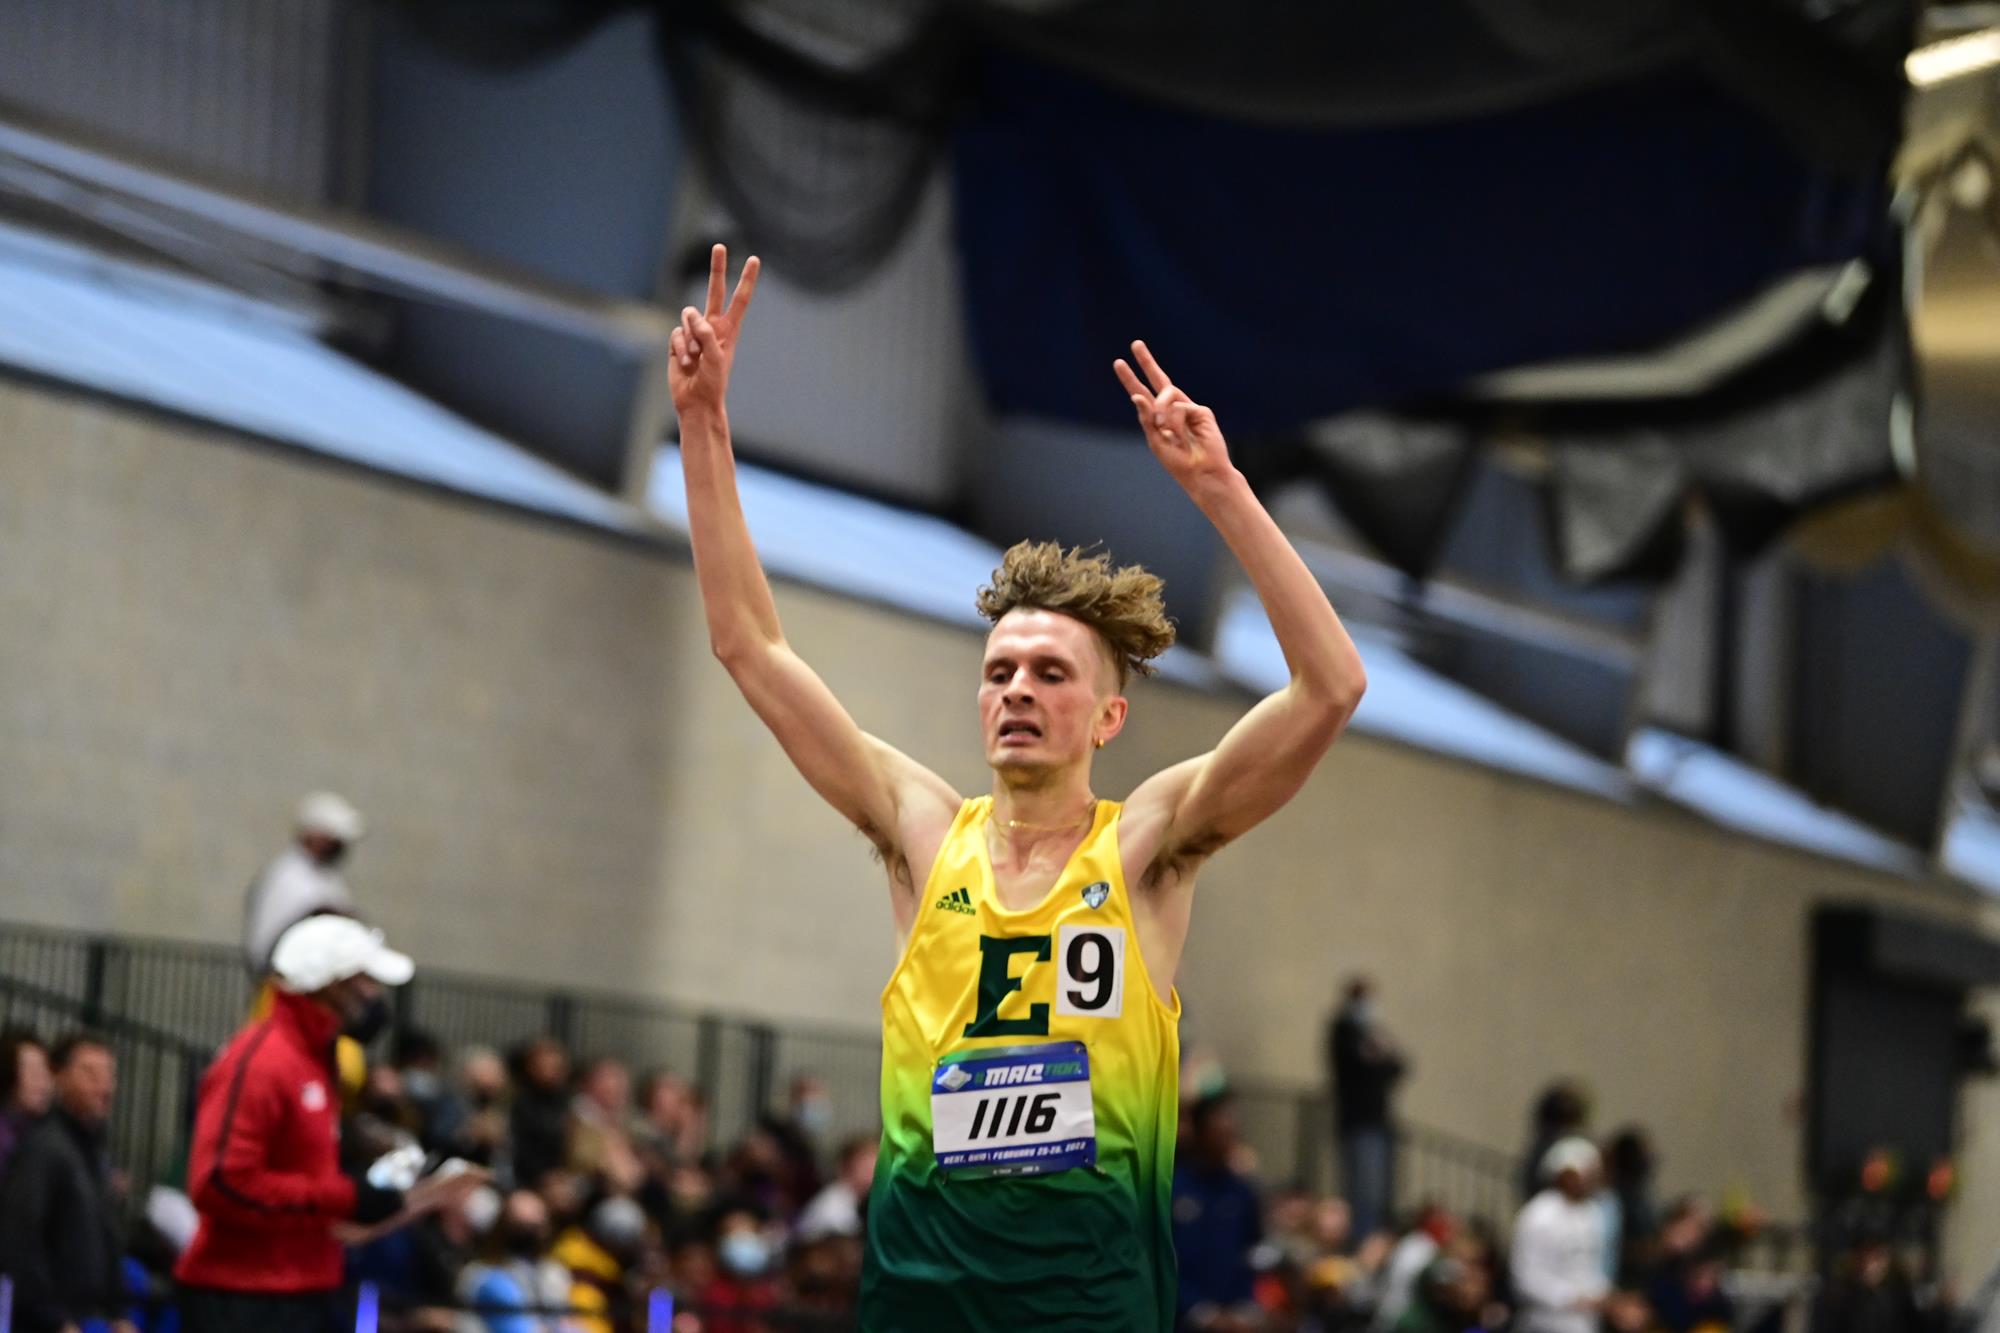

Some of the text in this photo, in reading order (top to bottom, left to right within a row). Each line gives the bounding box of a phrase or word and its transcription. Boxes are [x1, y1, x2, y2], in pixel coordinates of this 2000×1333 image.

[936, 900, 976, 917] adidas
[963, 934, 1051, 1038] E
[1066, 933, 1114, 1010] 9
[968, 1093, 1062, 1140] 1116
